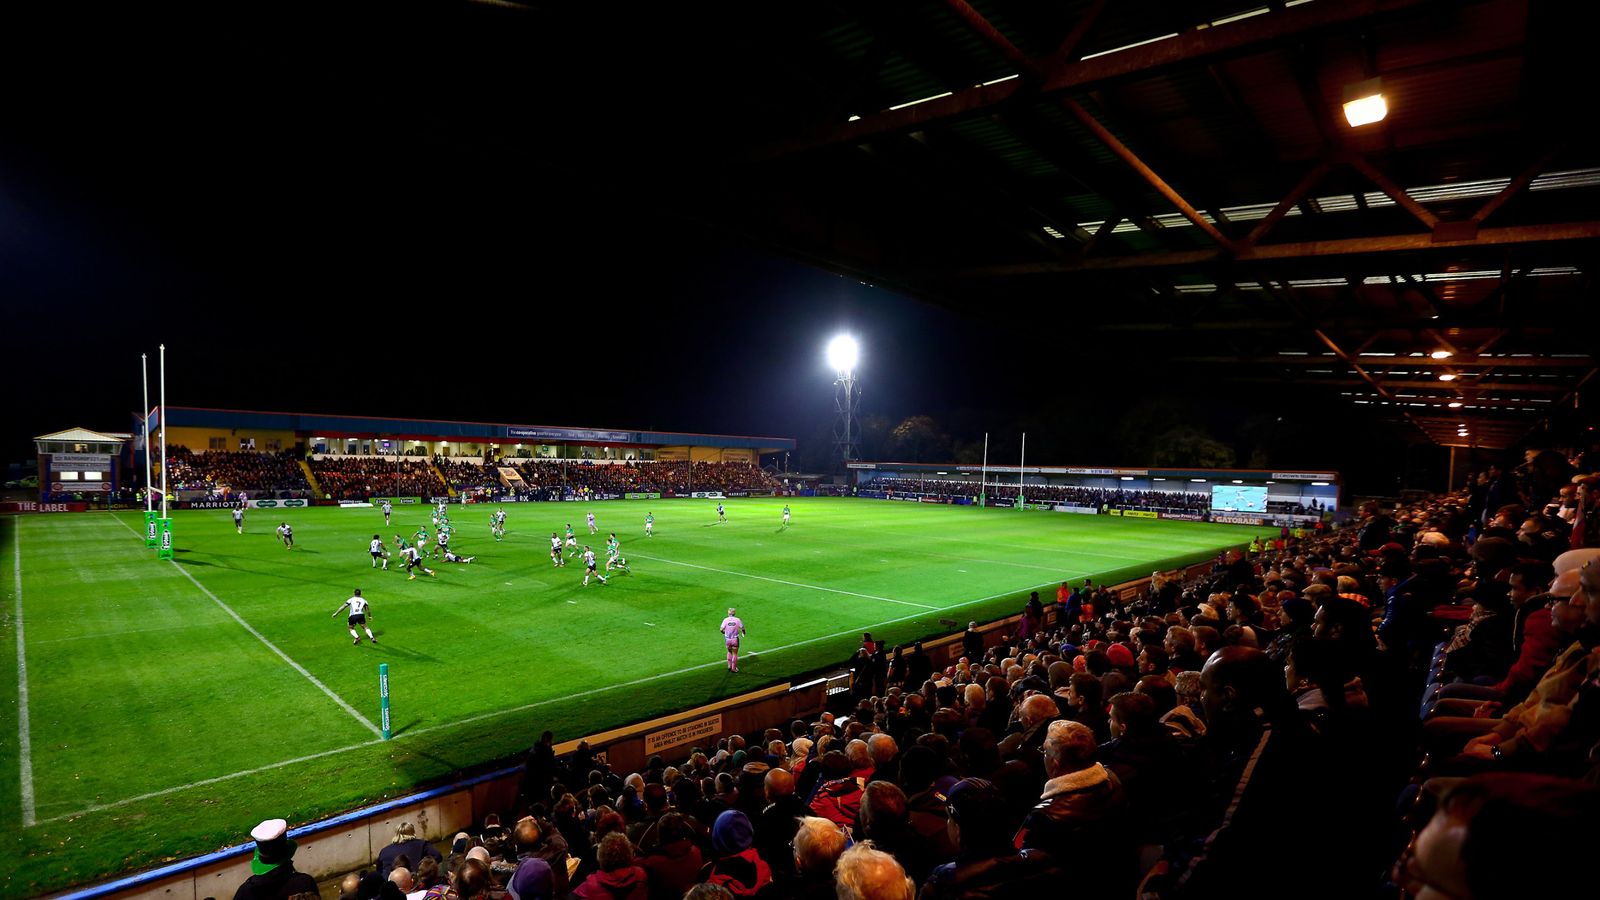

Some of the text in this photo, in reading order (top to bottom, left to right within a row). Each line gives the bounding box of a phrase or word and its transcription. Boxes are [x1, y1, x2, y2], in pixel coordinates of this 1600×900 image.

[18, 502, 69, 512] THE LABEL
[1216, 516, 1260, 525] GATORADE
